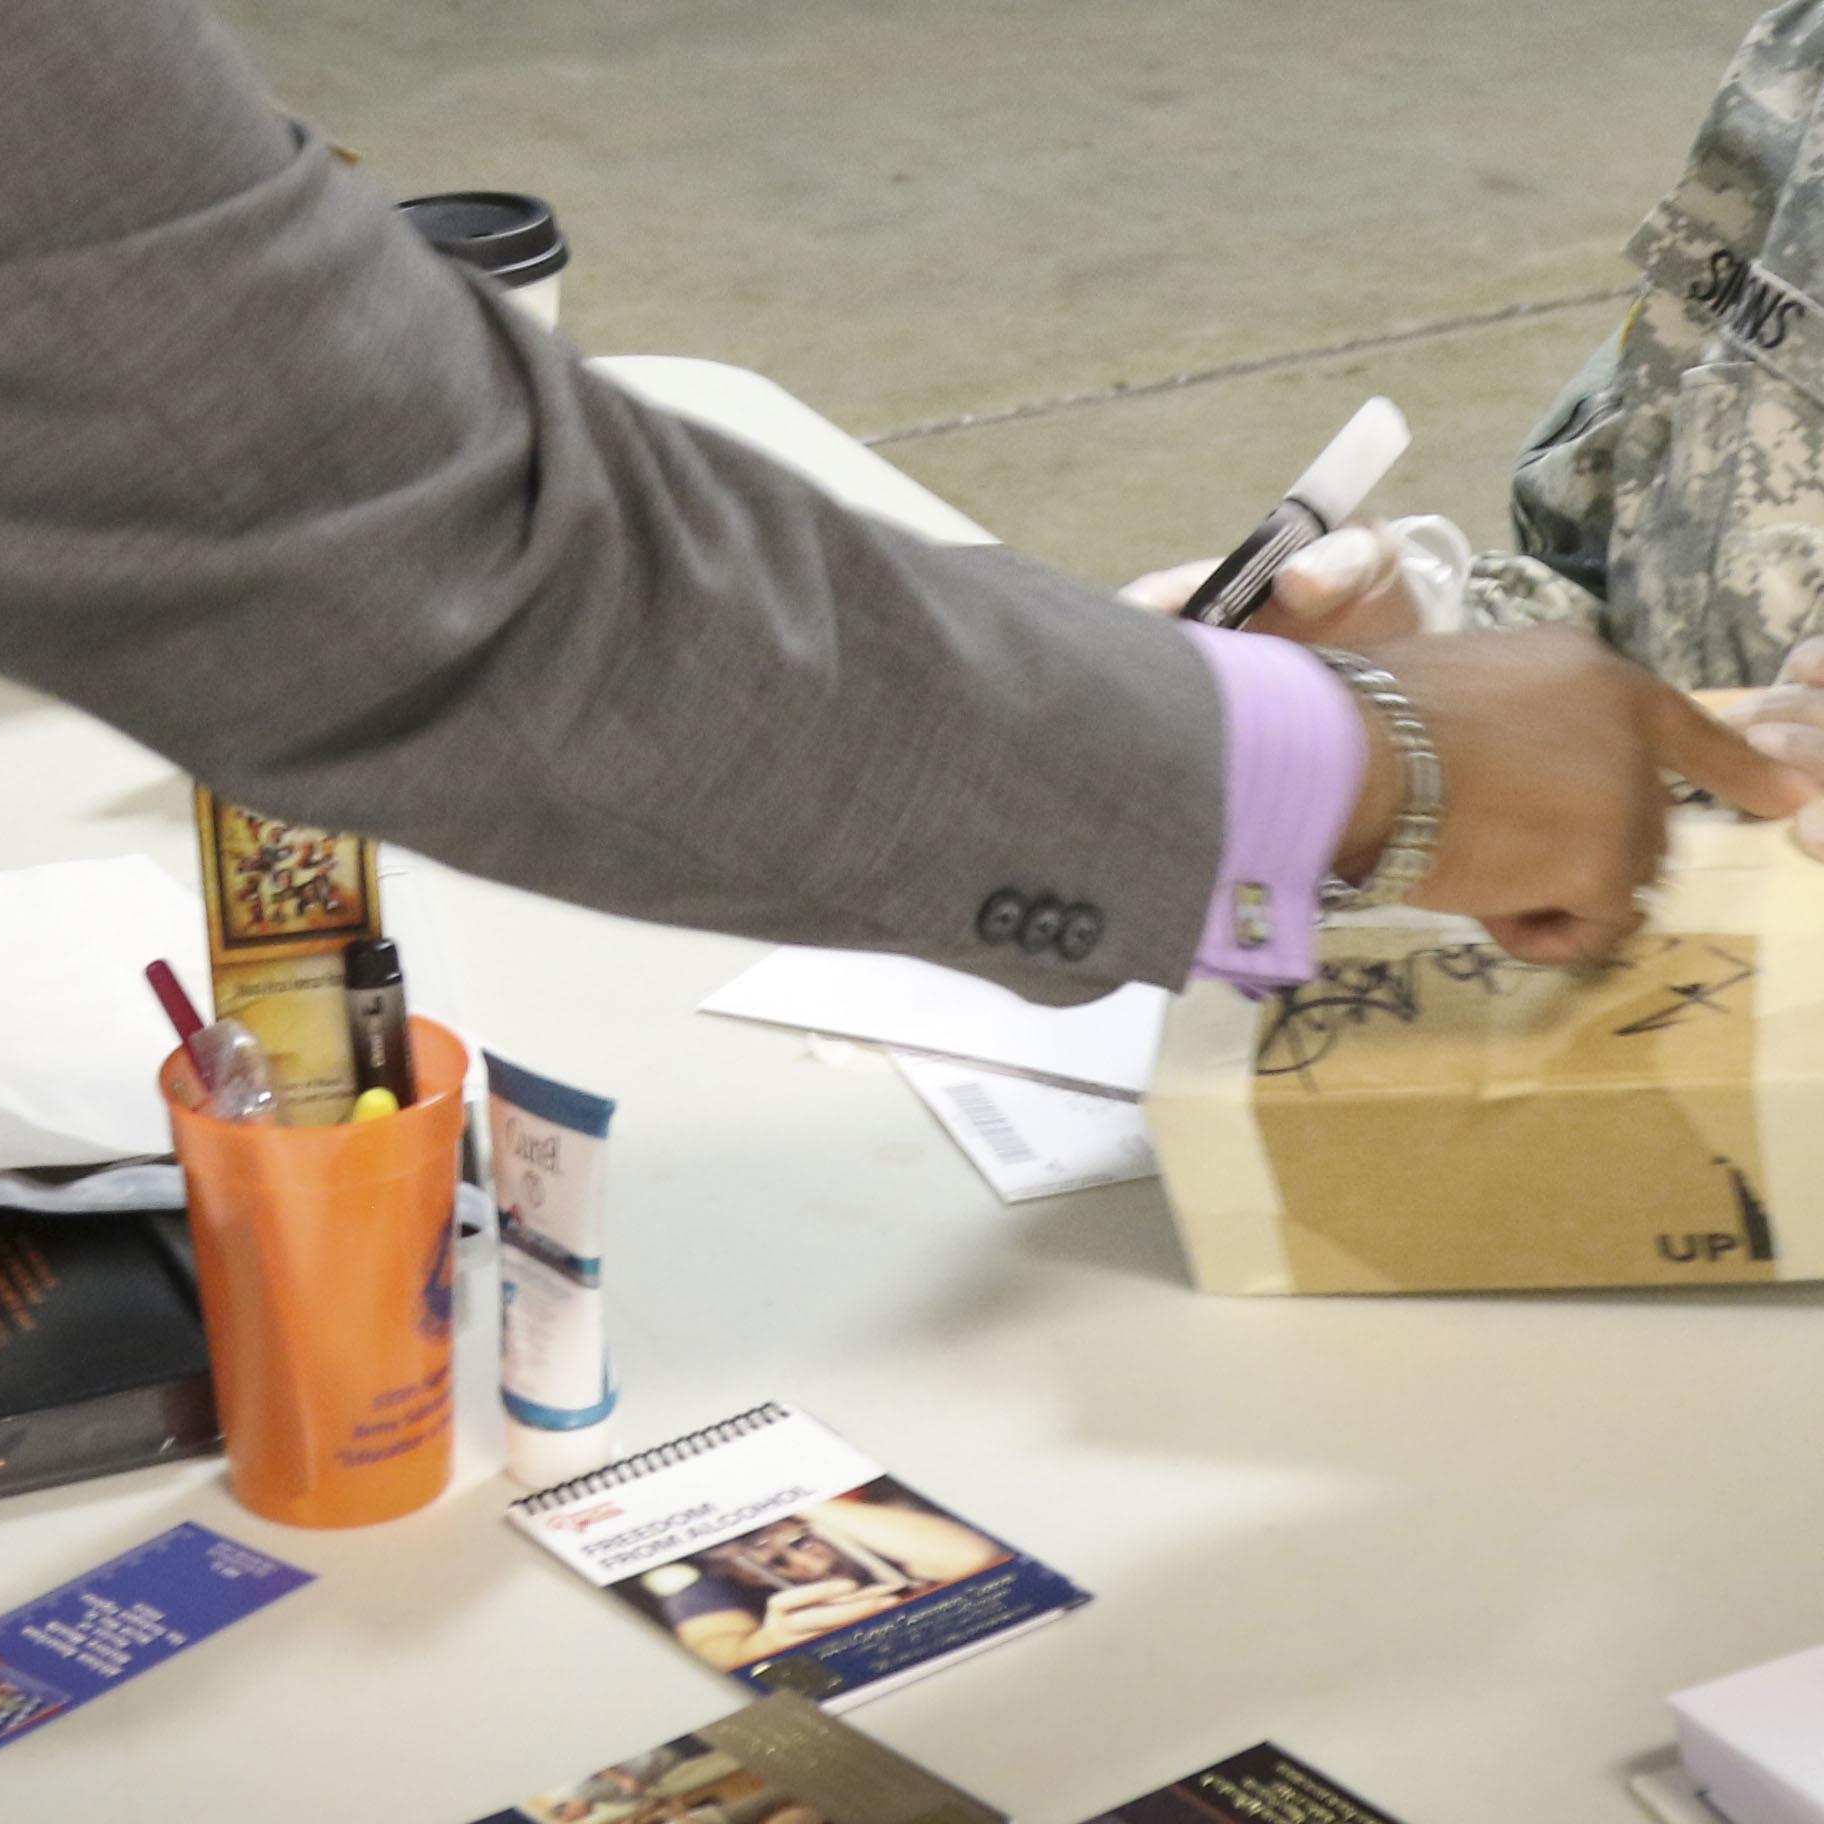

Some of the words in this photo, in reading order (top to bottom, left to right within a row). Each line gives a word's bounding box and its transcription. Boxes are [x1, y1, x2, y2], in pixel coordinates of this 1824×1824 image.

[1655, 1233, 1738, 1263] UP
[580, 1501, 719, 1556] FREEDOM
[597, 1533, 676, 1569] FROM
[686, 1484, 817, 1540] ALCOHOL
